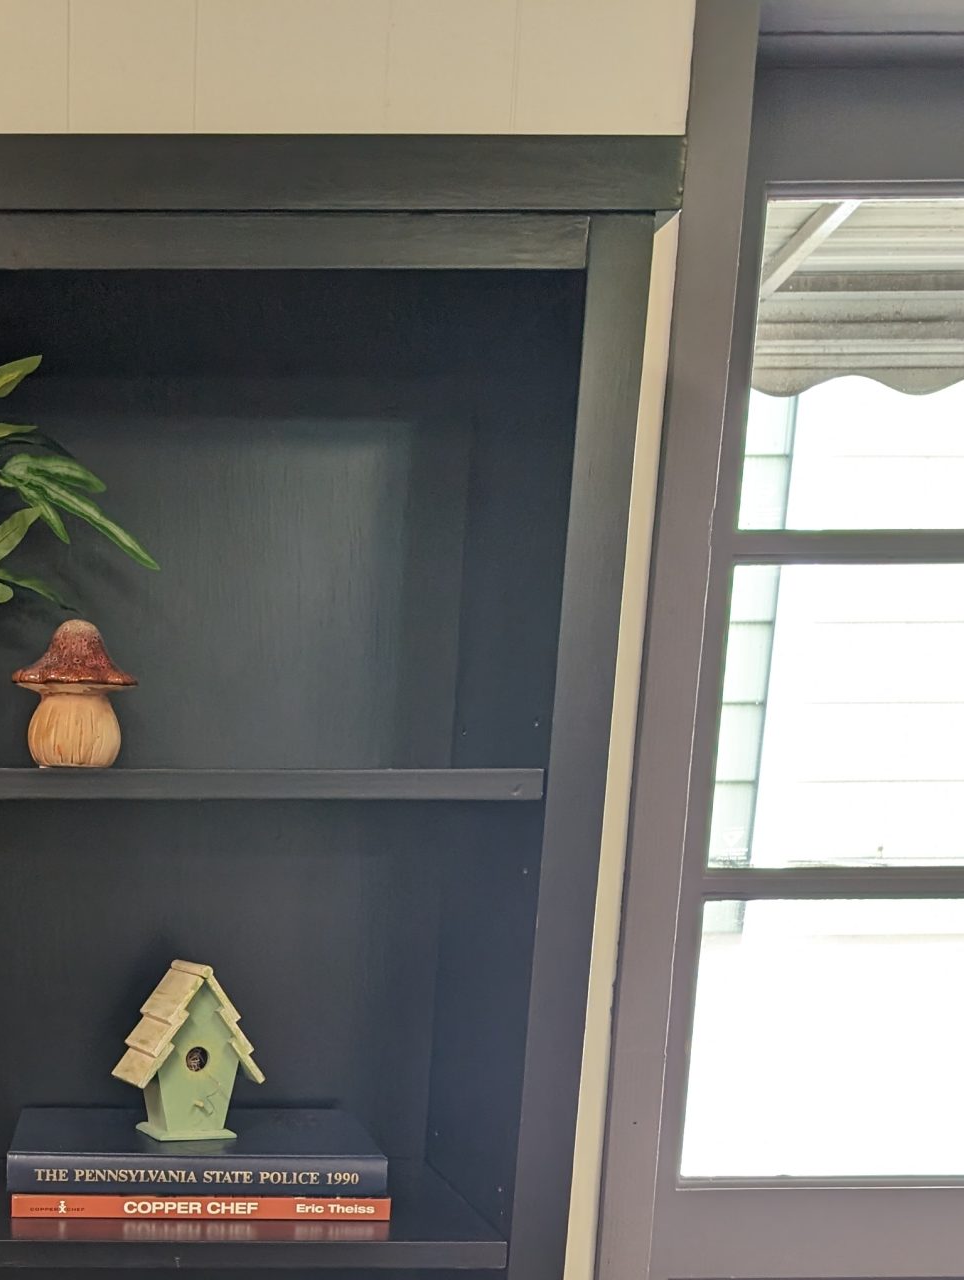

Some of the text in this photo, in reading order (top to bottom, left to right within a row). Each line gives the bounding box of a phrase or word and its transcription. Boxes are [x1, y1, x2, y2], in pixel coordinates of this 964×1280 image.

[34, 1169, 360, 1185] THE PENNSYLVANIA STATE POLICE 1990
[123, 1201, 259, 1215] COPPER CHEF
[296, 1203, 375, 1214] Eric Theiss
